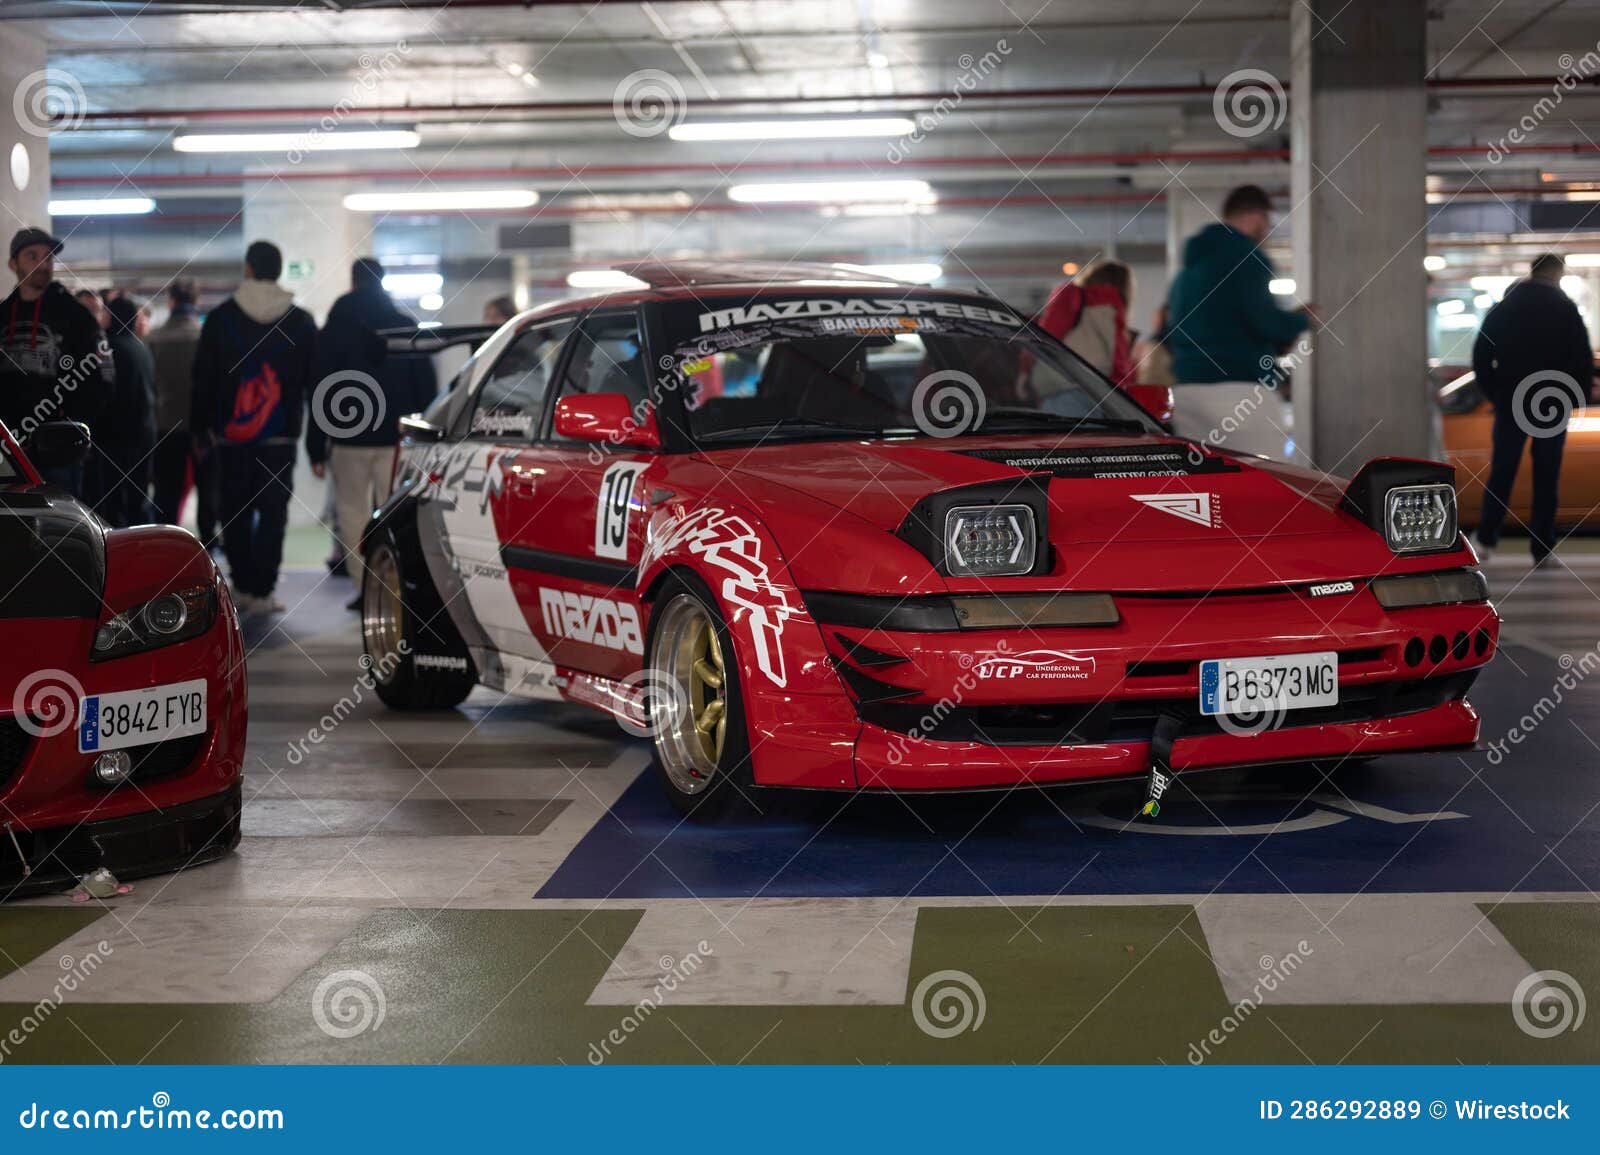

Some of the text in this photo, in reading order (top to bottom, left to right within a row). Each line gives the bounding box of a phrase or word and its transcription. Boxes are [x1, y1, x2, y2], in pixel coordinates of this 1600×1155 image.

[699, 299, 1020, 332] MAZDASPEED
[603, 468, 635, 548] 19
[979, 665, 1024, 679] UCP
[1225, 671, 1240, 702] B
[1244, 667, 1301, 700] 6373
[1306, 664, 1334, 696] MG
[101, 700, 159, 737] 3842
[166, 692, 202, 728] FYB
